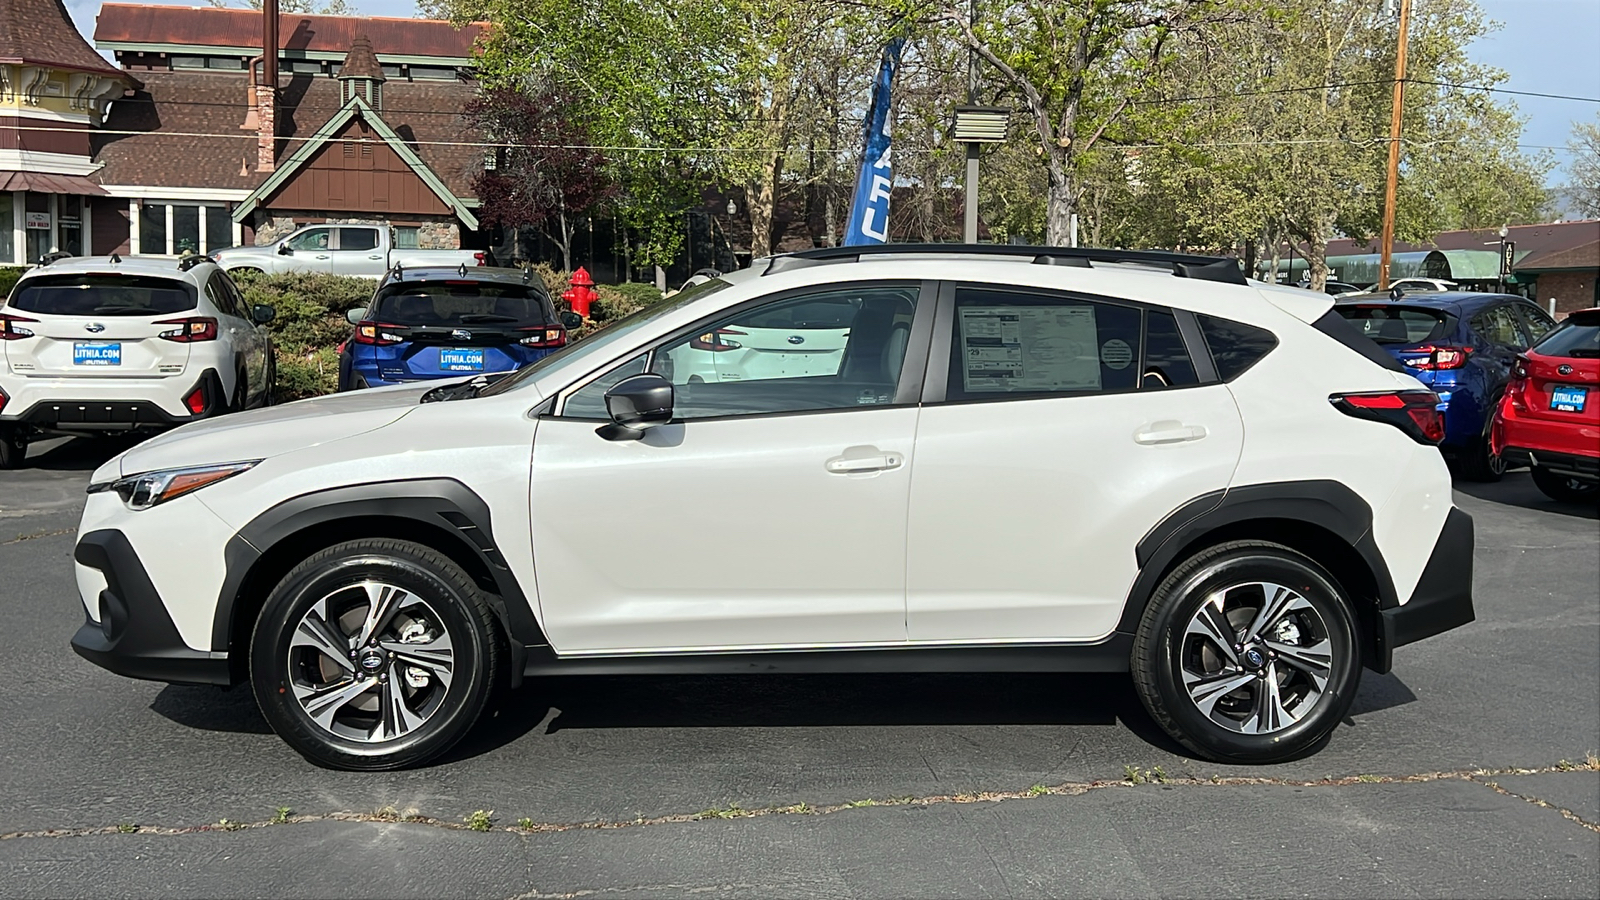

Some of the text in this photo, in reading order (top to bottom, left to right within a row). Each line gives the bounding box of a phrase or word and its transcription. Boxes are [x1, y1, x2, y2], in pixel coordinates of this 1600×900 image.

[1505, 243, 1513, 274] AURA
[75, 349, 120, 358] LITHIA.COM
[441, 355, 483, 363] LITHIA.COM
[1552, 392, 1585, 404] LITHIA.COM
